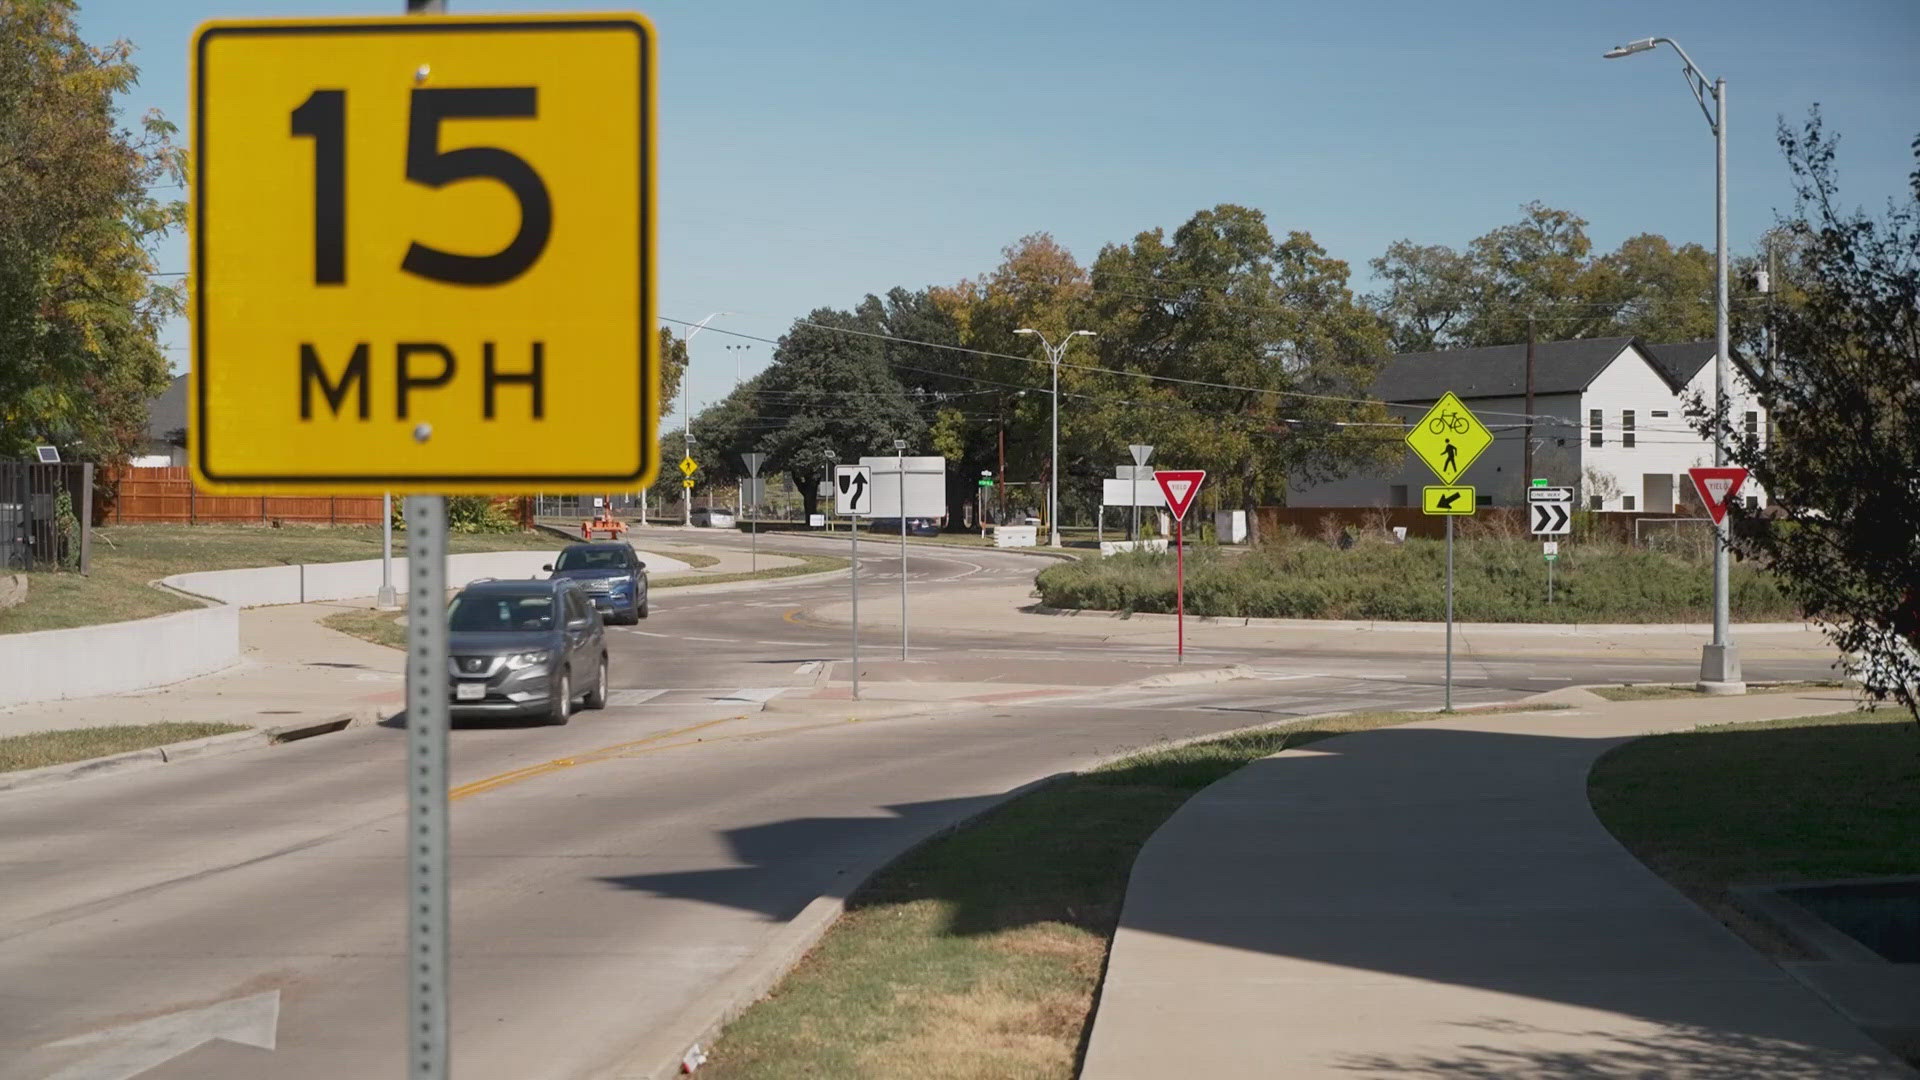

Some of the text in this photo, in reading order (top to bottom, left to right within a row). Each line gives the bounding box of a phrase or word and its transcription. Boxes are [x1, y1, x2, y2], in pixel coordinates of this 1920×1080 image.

[290, 86, 555, 289] 15
[299, 341, 545, 421] MPH
[1709, 482, 1729, 490] YIELD
